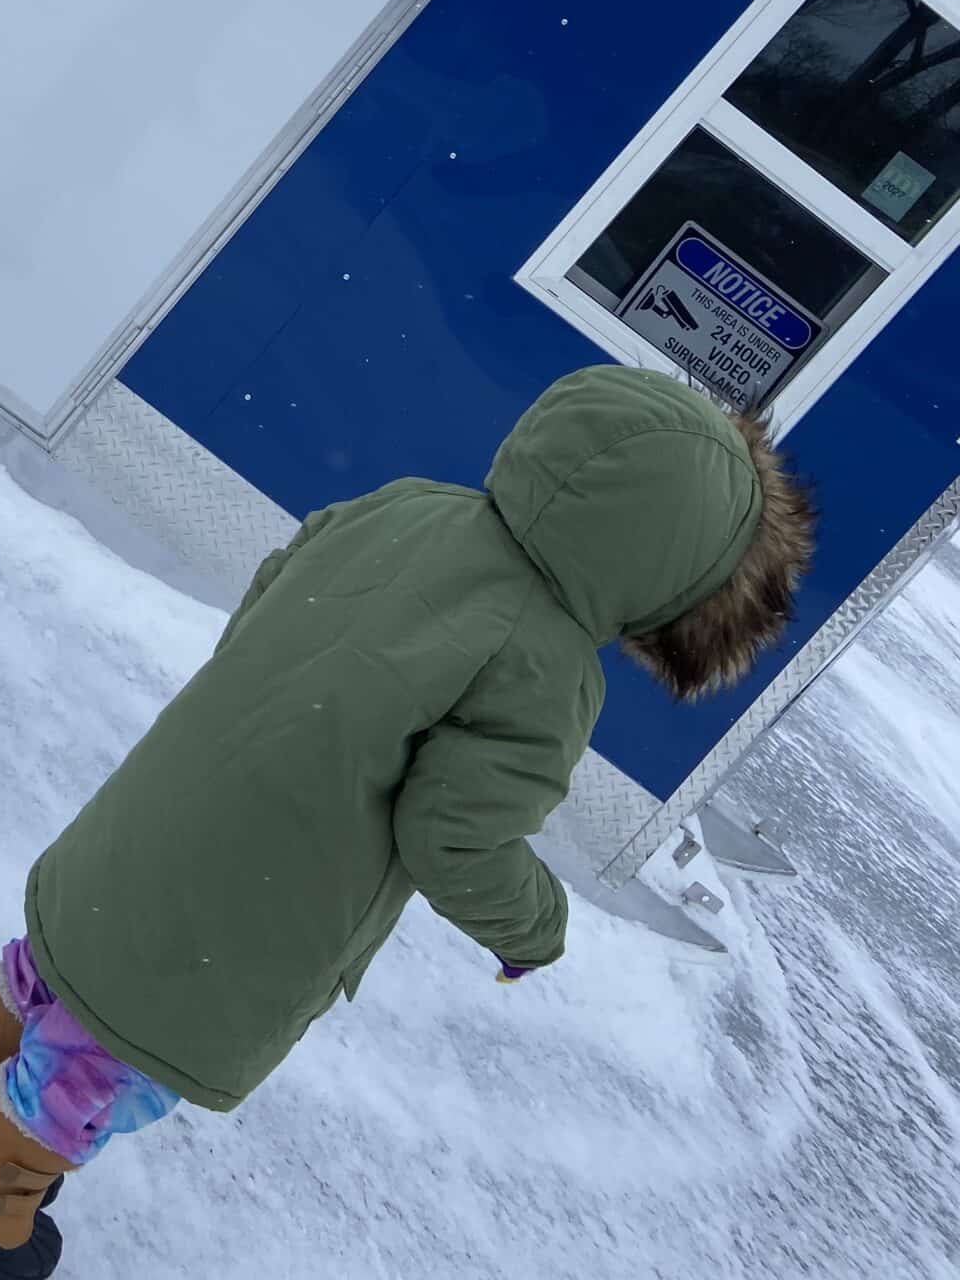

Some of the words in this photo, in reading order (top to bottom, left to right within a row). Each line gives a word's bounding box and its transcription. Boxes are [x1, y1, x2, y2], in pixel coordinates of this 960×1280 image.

[691, 288, 712, 309] THIS
[713, 305, 739, 329] AREA
[737, 324, 749, 337] IS
[748, 332, 781, 362] UNDER
[702, 261, 786, 327] NOTICE
[664, 337, 748, 406] SURVEILLANCE
[708, 346, 750, 385] VIDEO
[710, 325, 729, 346] 24
[730, 340, 771, 376] HOUR
